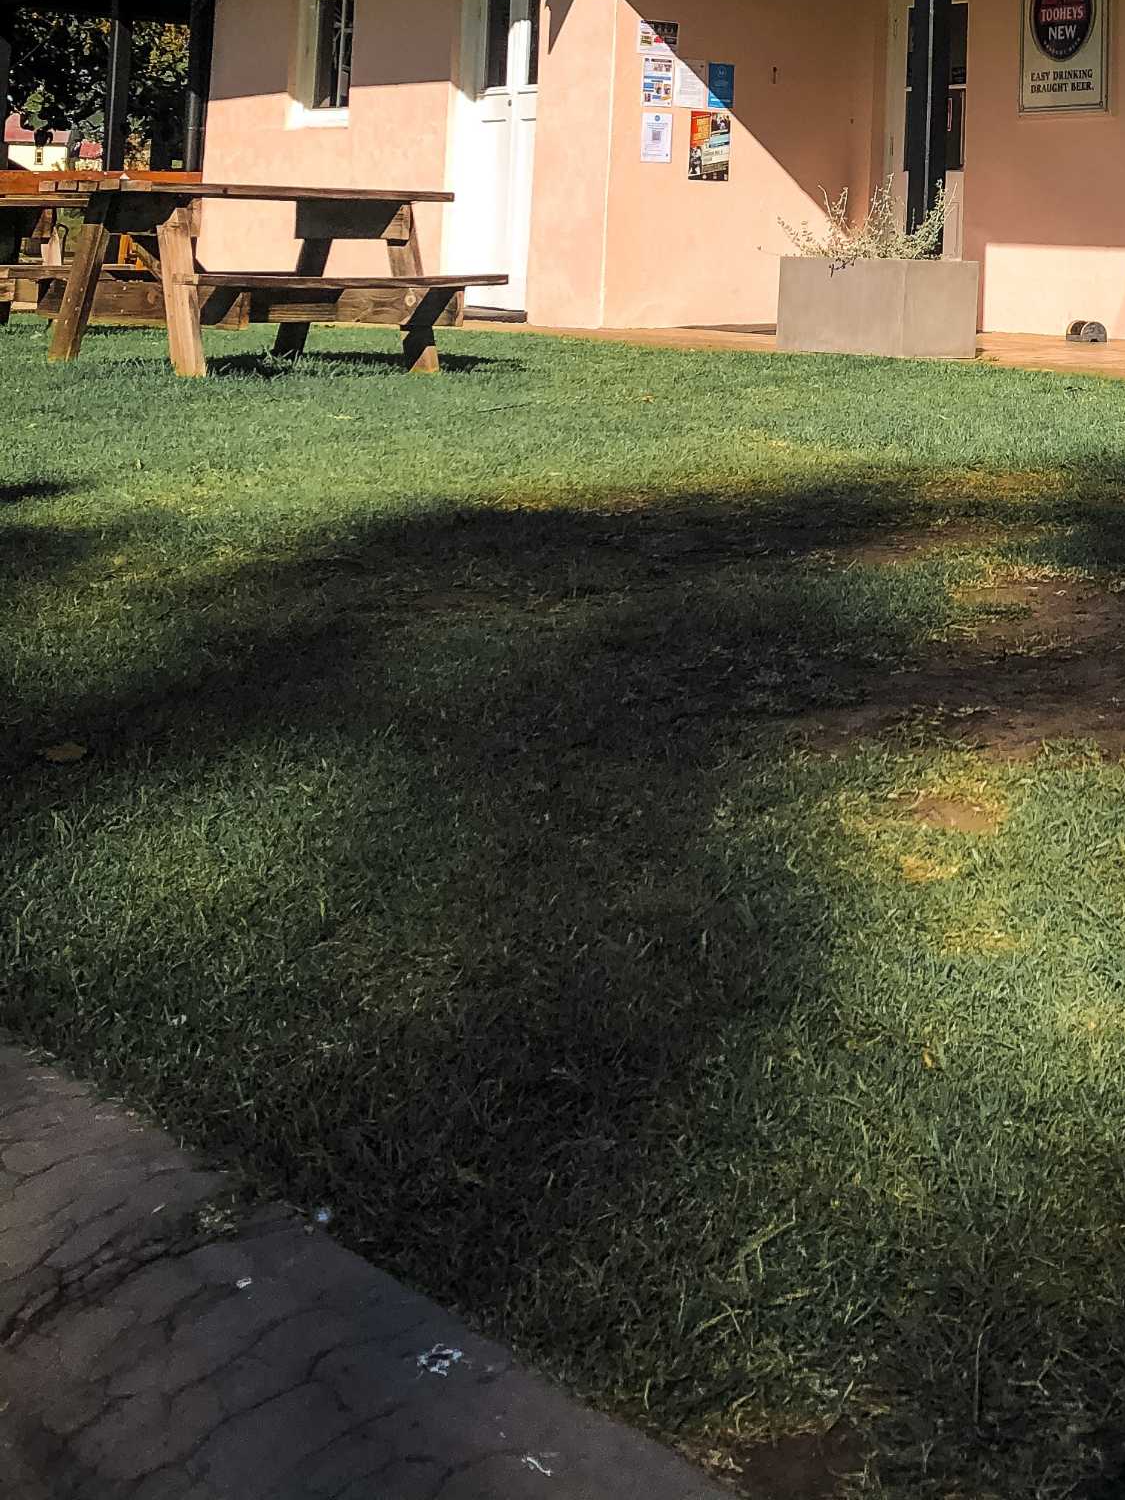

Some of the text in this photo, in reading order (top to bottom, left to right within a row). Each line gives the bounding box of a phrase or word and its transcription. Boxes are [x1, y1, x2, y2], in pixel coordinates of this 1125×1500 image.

[1040, 5, 1084, 22] TOOHEYS
[1049, 24, 1077, 40] NEW
[1030, 68, 1093, 82] EASY DRINKING
[1030, 82, 1068, 94] DRAUGHT
